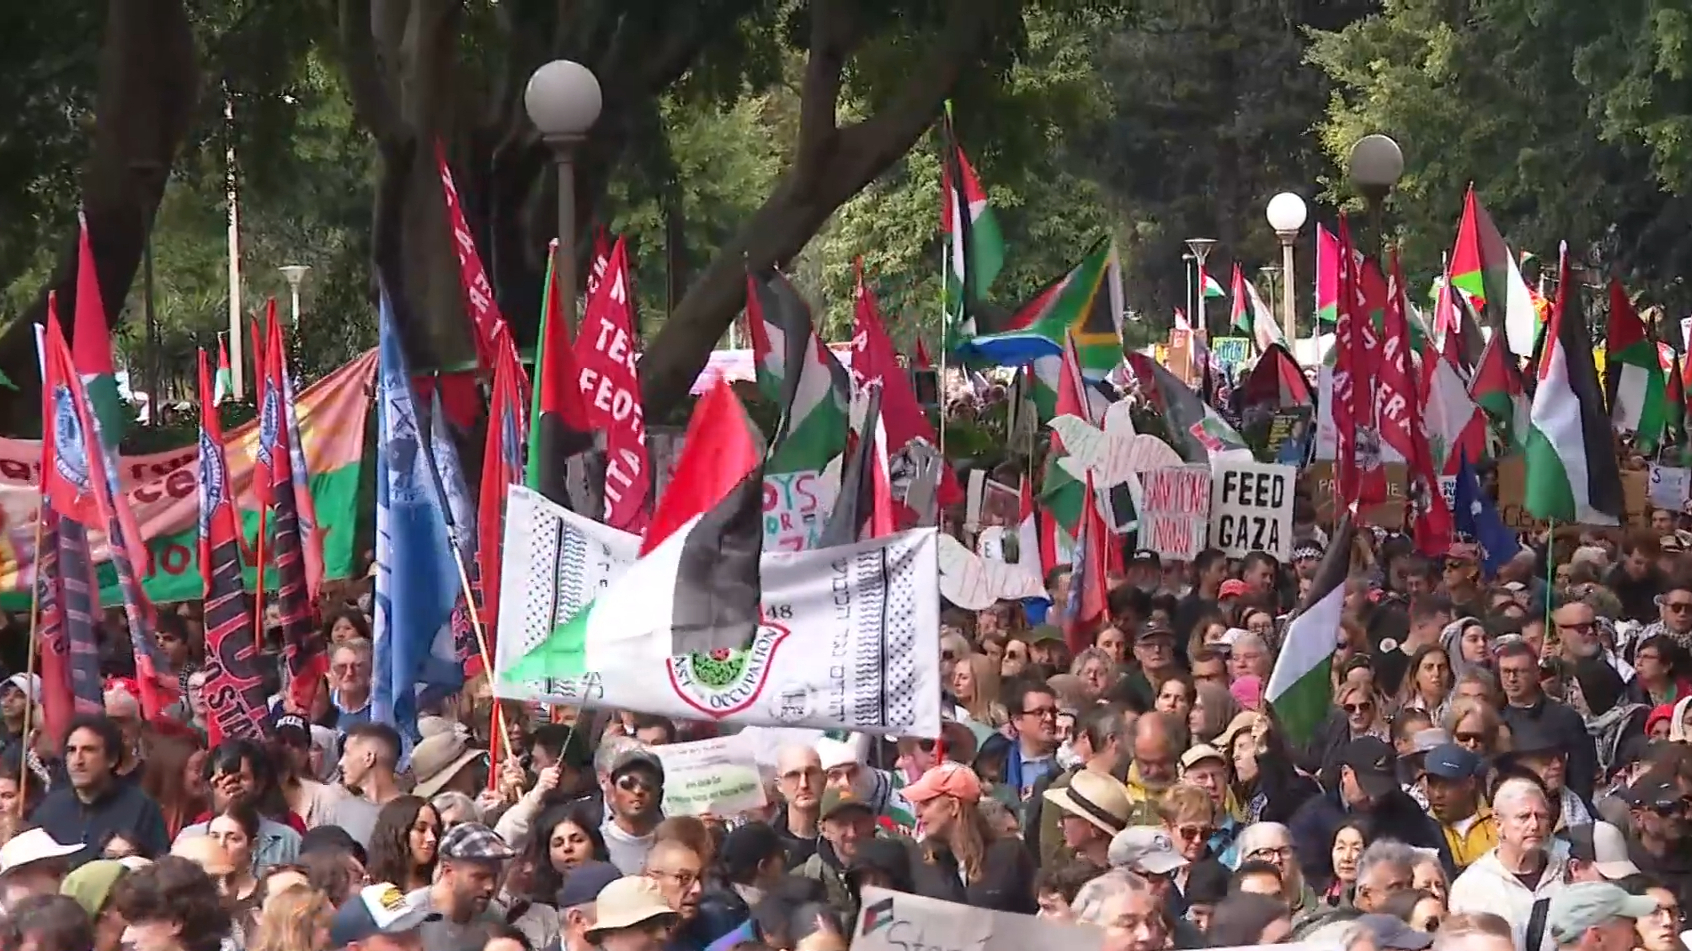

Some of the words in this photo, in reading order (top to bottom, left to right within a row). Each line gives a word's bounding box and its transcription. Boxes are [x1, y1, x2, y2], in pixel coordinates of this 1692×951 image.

[1222, 470, 1285, 509] FEED
[1218, 514, 1280, 552] GAZA
[709, 628, 778, 709] OCCUPATION
